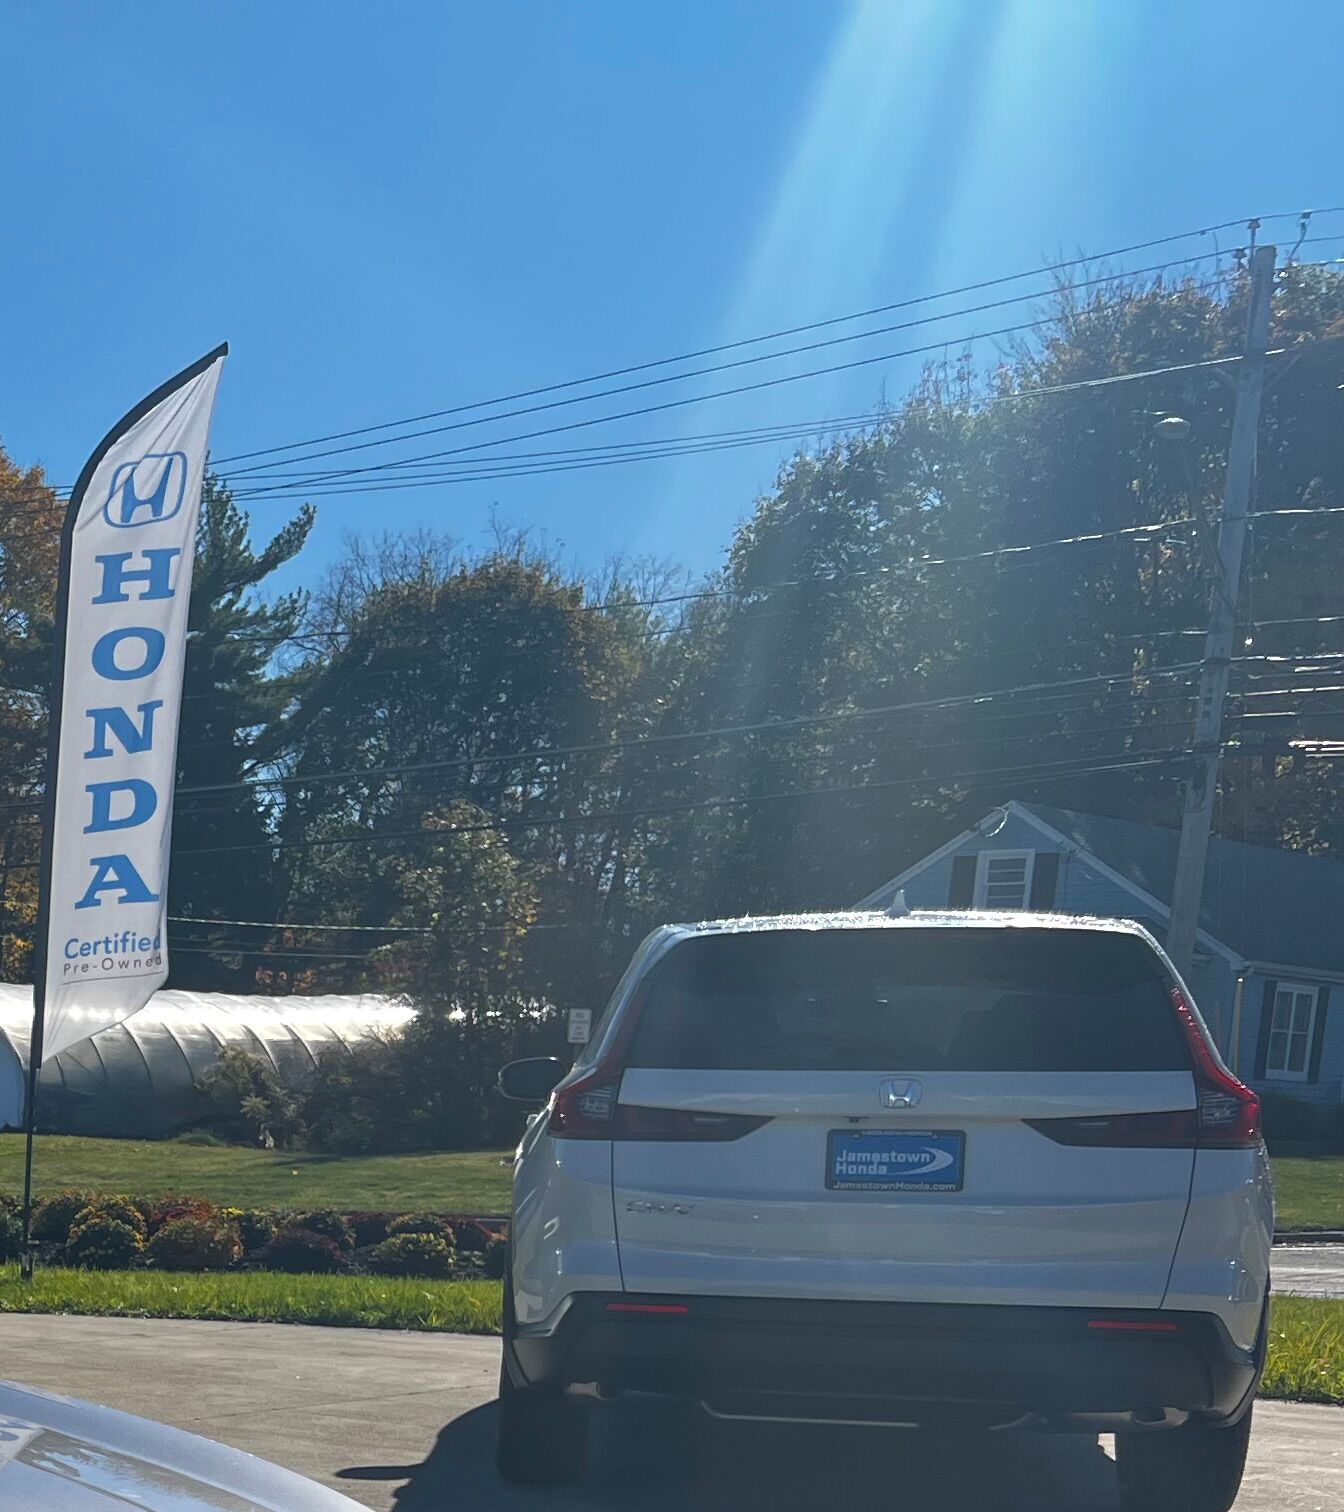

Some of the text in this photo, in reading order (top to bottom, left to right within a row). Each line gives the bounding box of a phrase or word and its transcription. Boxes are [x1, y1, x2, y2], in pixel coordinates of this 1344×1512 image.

[75, 548, 181, 910] HONDA
[63, 929, 161, 959] Certified
[63, 952, 162, 976] Pre-Owned
[836, 1149, 931, 1162] Jamestown
[836, 1162, 888, 1175] Honda
[833, 1181, 955, 1191] JamestownHonda.com
